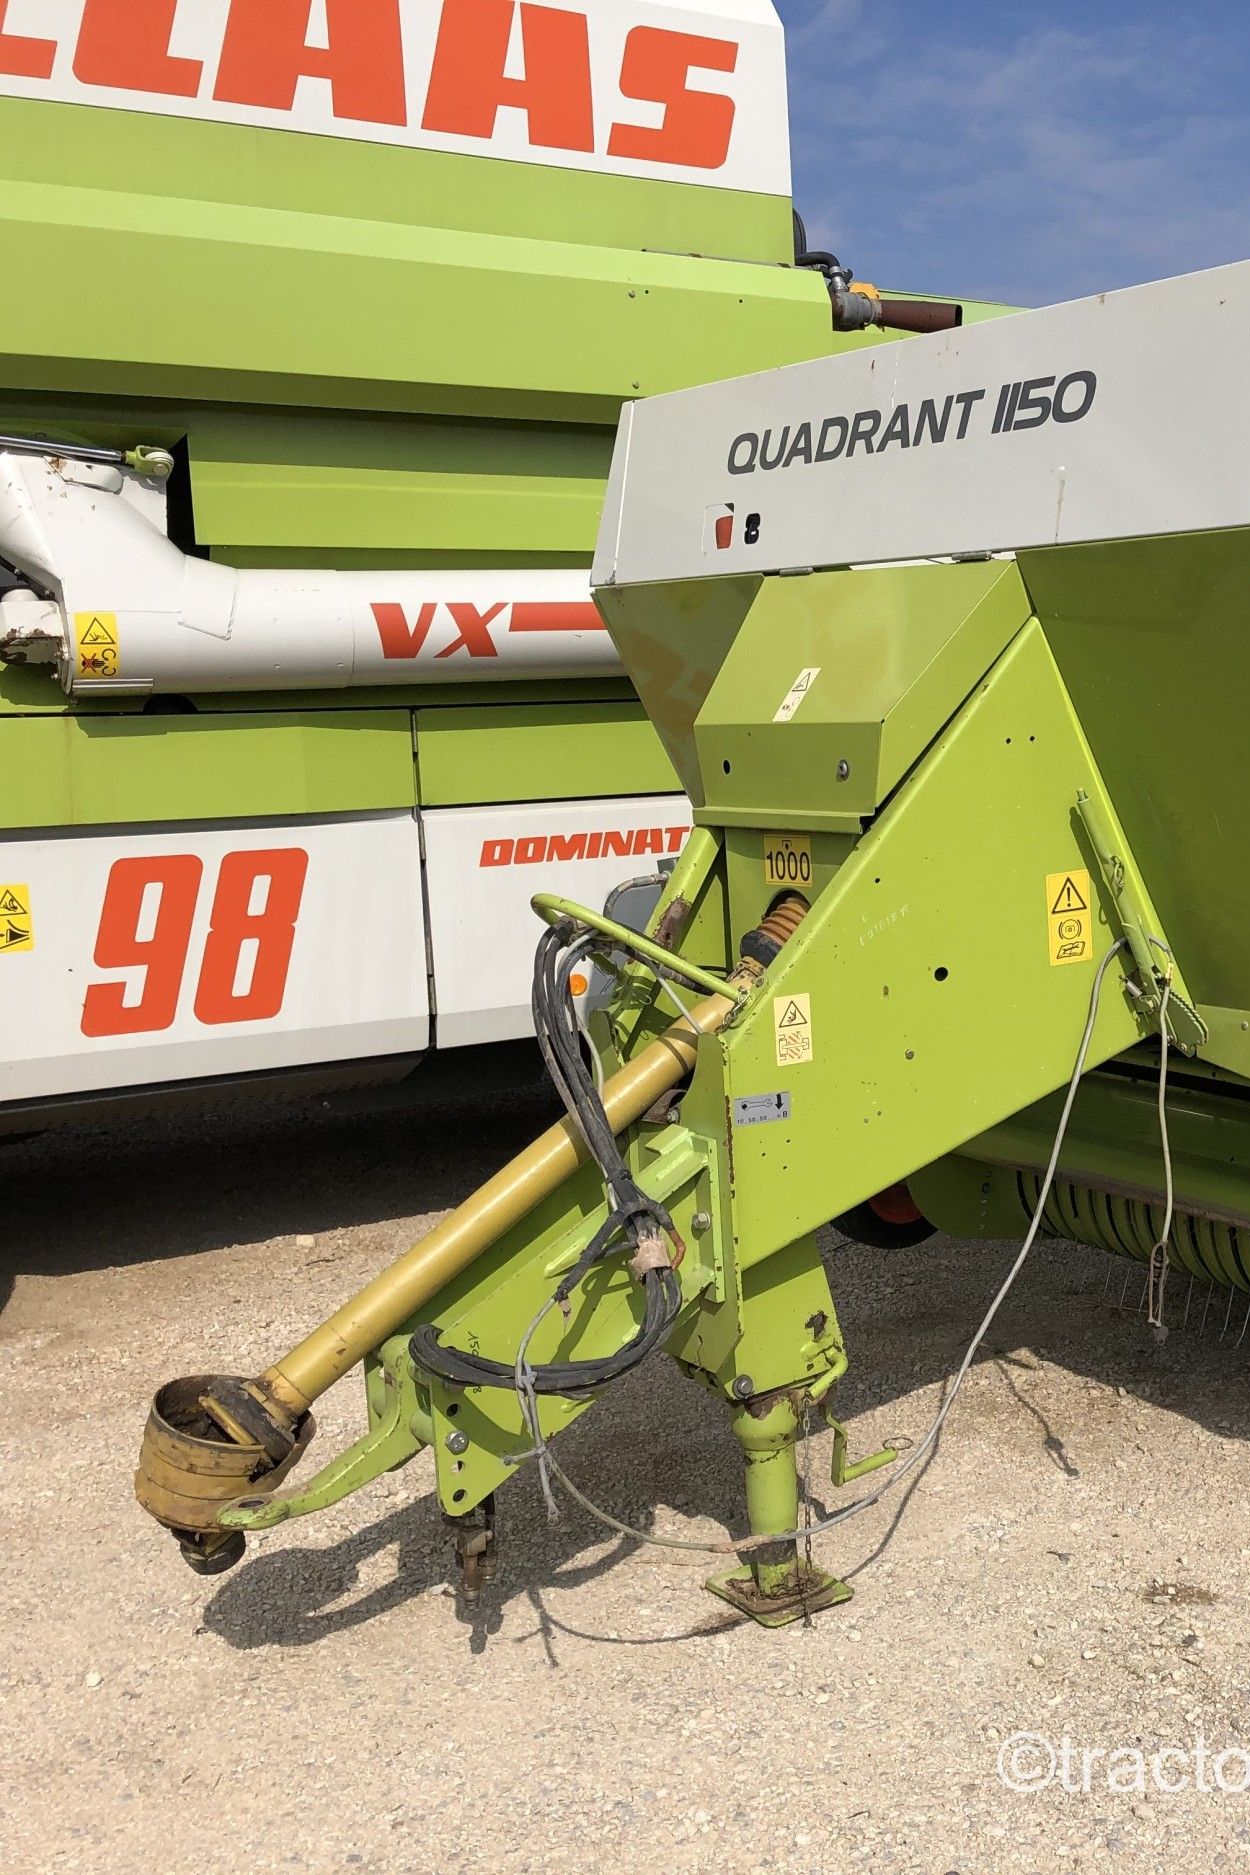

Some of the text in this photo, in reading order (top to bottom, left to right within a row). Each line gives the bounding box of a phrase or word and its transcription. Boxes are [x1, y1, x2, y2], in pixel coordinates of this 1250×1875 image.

[0, 0, 738, 170] LAAS
[727, 370, 1097, 475] QUADRANT 1150
[371, 602, 511, 658] VX
[479, 825, 694, 868] DOMINAT
[766, 850, 810, 882] 1000
[80, 847, 309, 1038] 98
